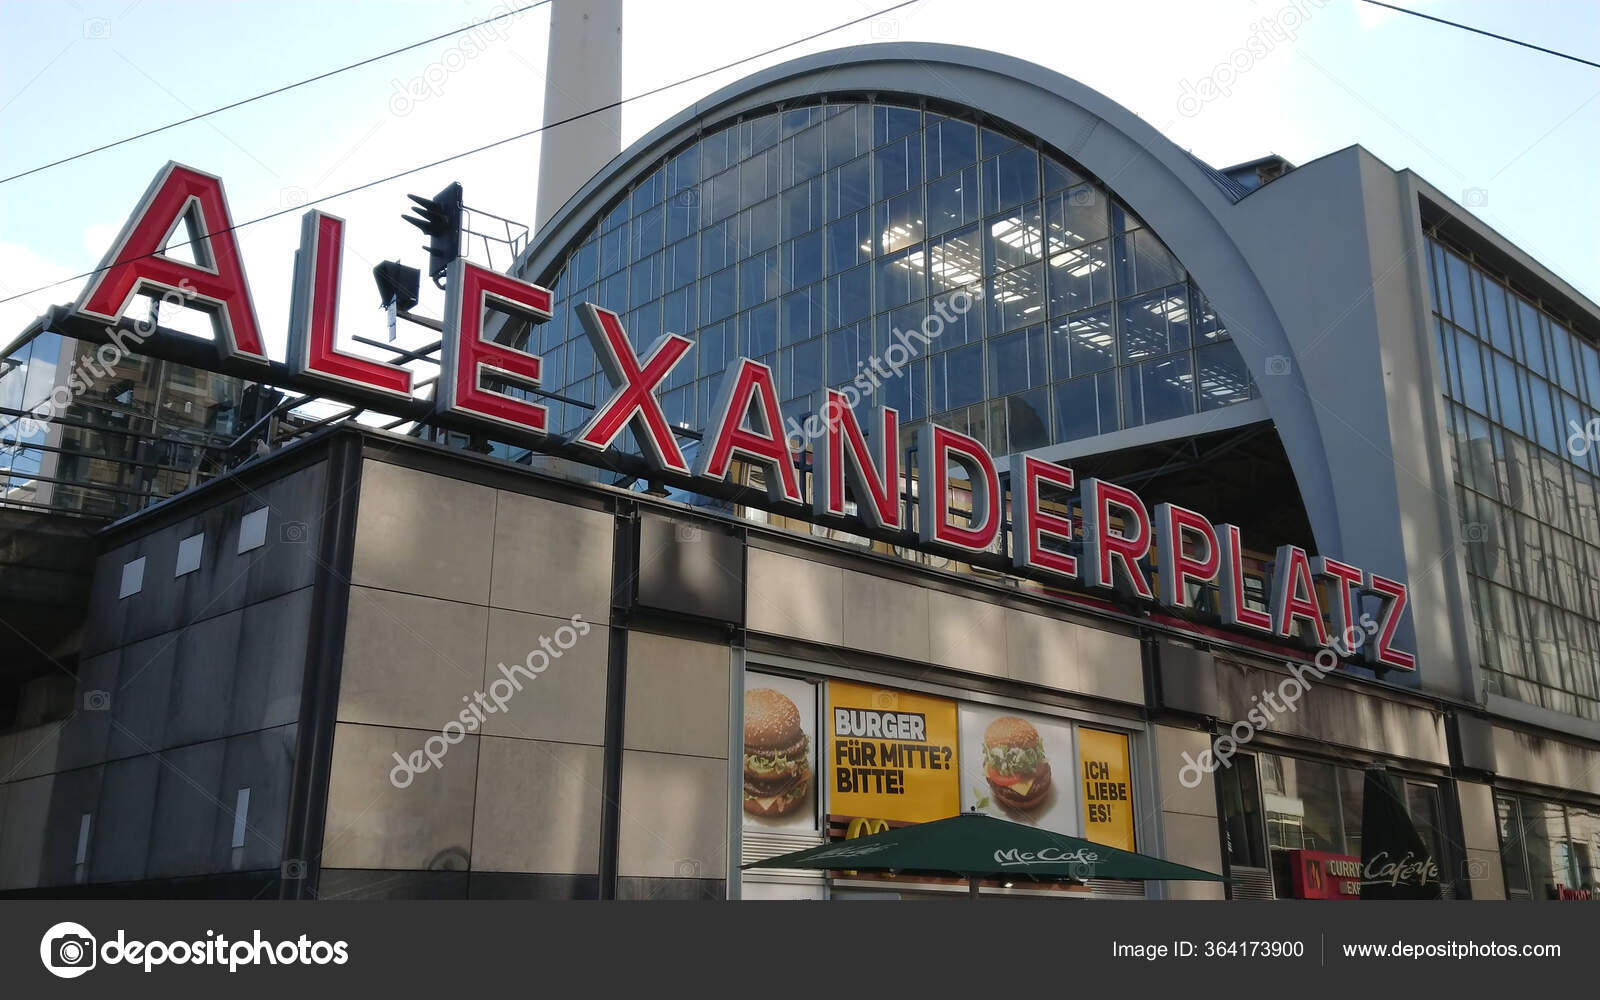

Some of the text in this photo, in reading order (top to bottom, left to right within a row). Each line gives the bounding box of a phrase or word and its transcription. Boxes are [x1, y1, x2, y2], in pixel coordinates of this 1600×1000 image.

[76, 161, 1417, 671] ALEXANDERPLATZ
[834, 708, 925, 740] BURGER
[880, 743, 953, 770] MITTE?
[836, 767, 904, 795] BITTE!
[1084, 761, 1109, 780] ICH
[1086, 781, 1127, 801] LIEBE
[1088, 803, 1112, 823] ES!
